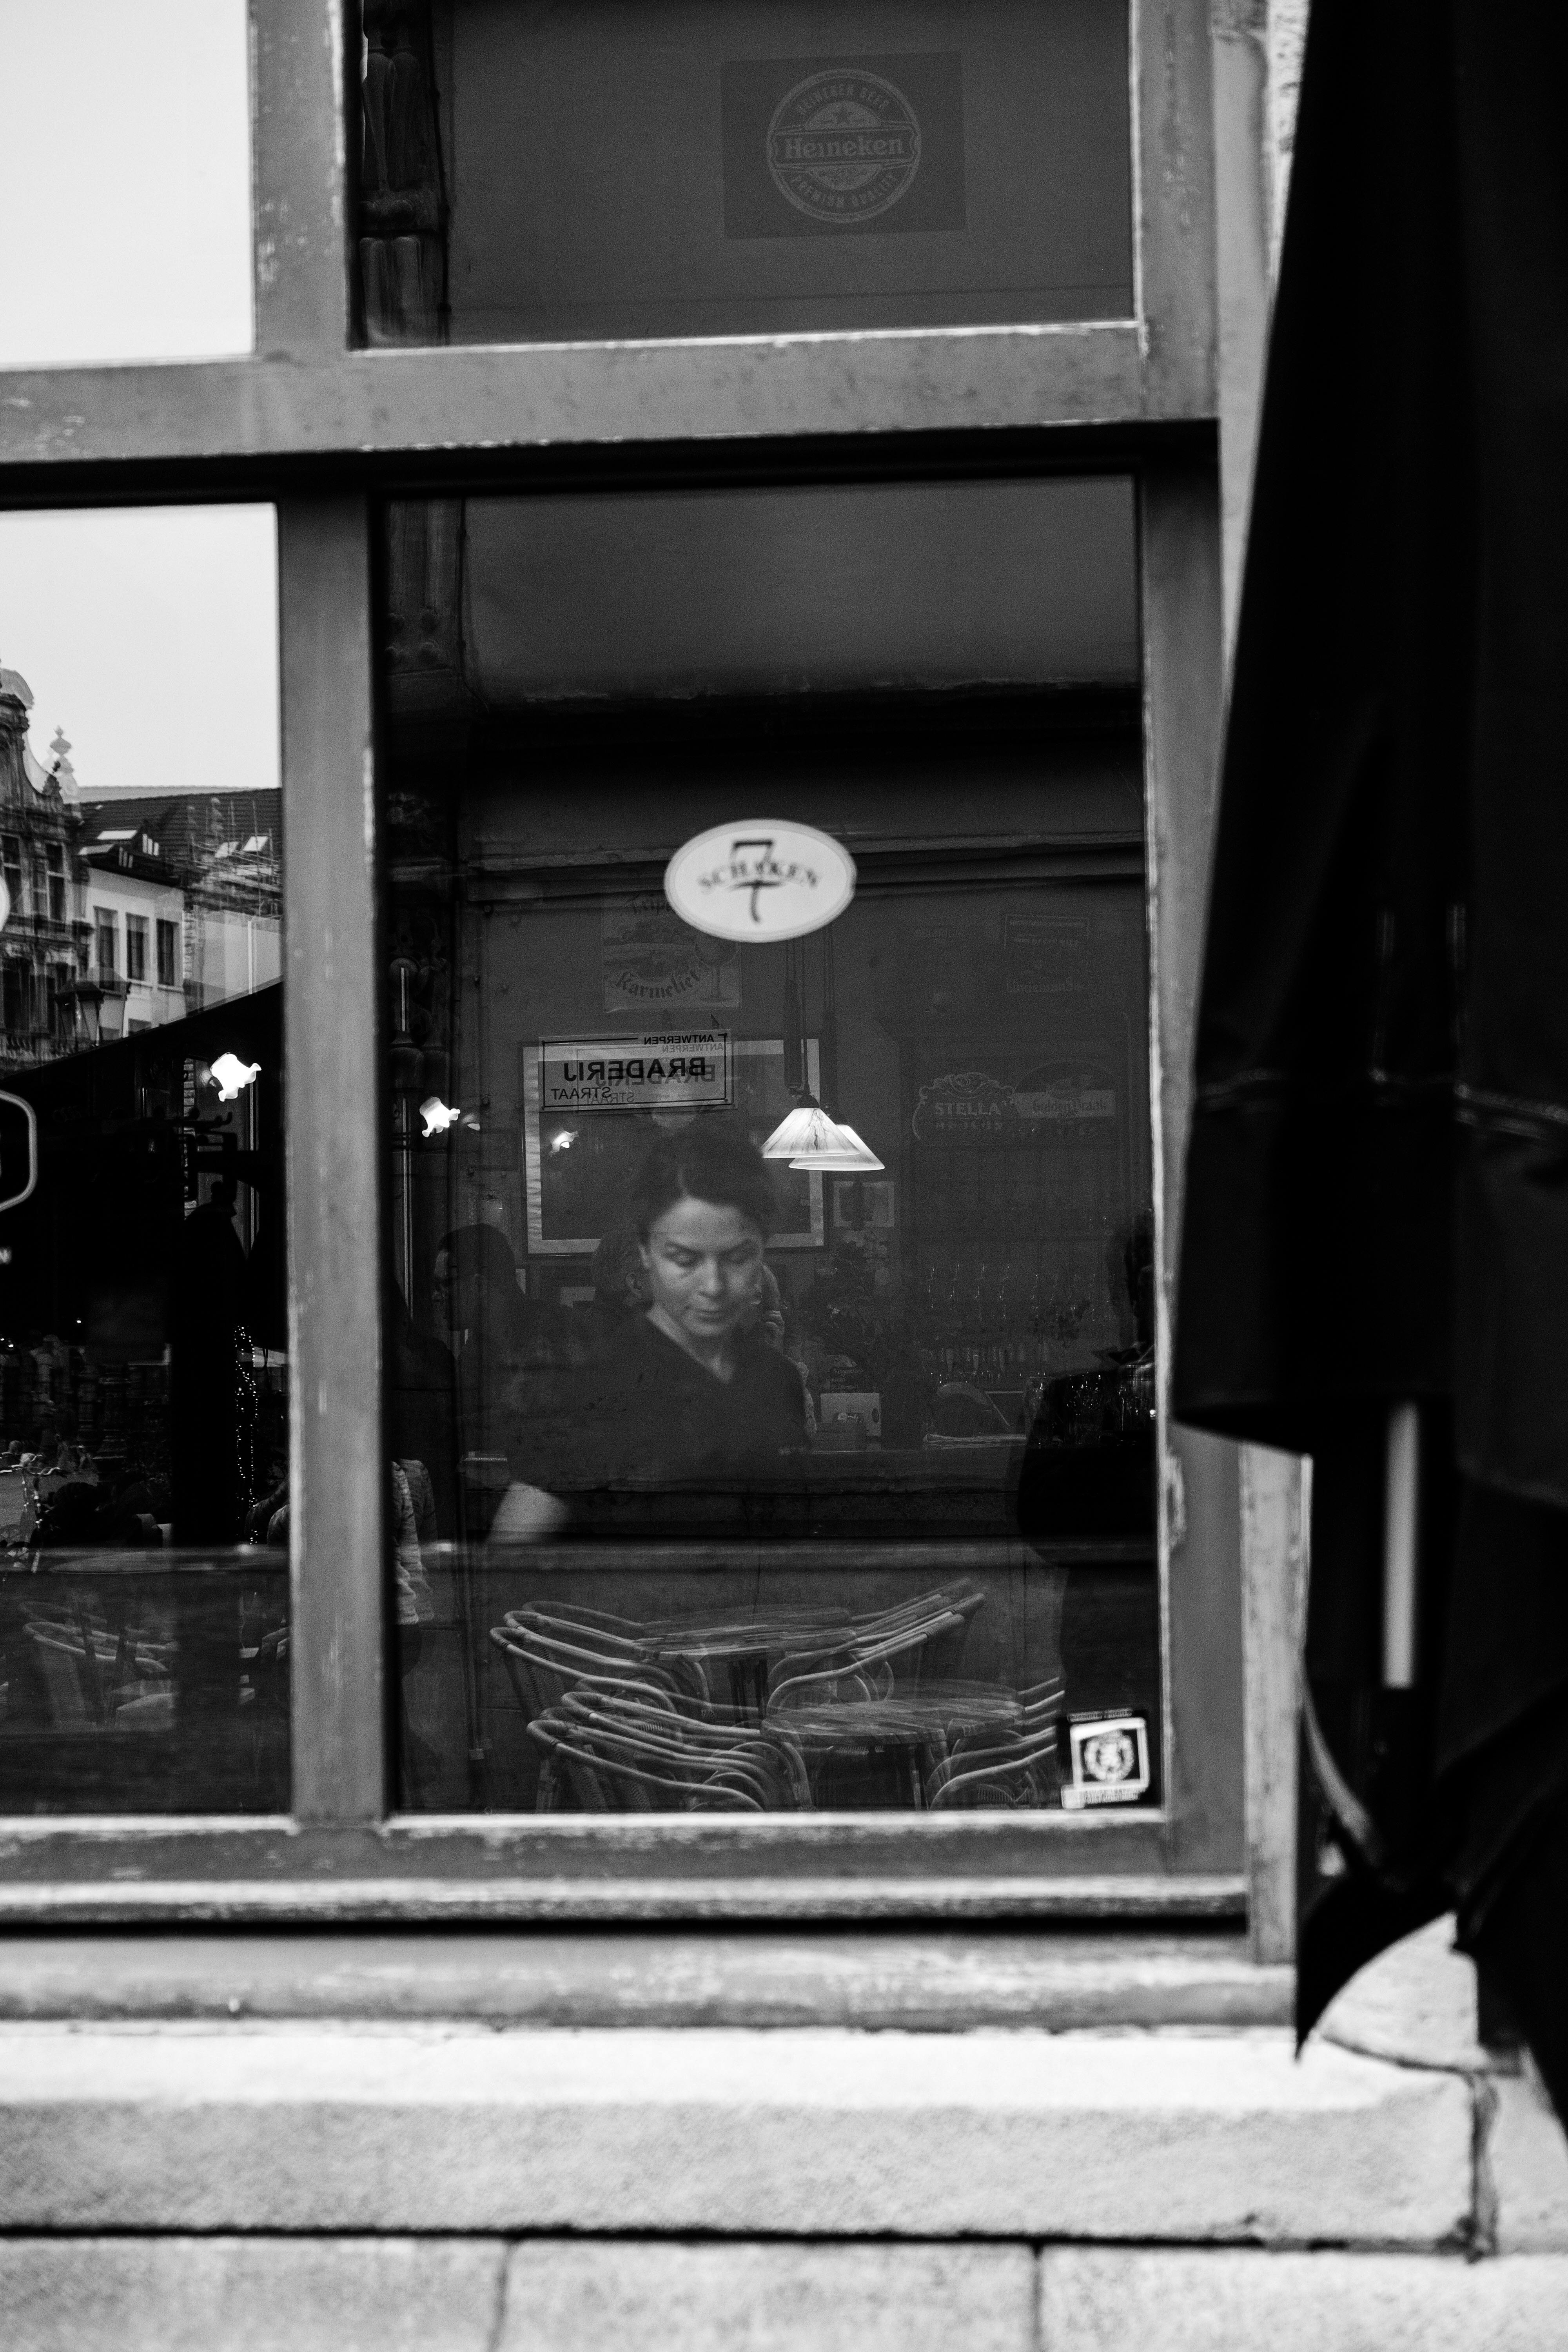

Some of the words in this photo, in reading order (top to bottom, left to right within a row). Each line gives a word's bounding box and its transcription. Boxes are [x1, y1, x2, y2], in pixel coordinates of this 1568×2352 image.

[785, 136, 904, 159] Heineken
[616, 969, 700, 998] Karmeliet
[935, 1102, 1001, 1116] STELLA
